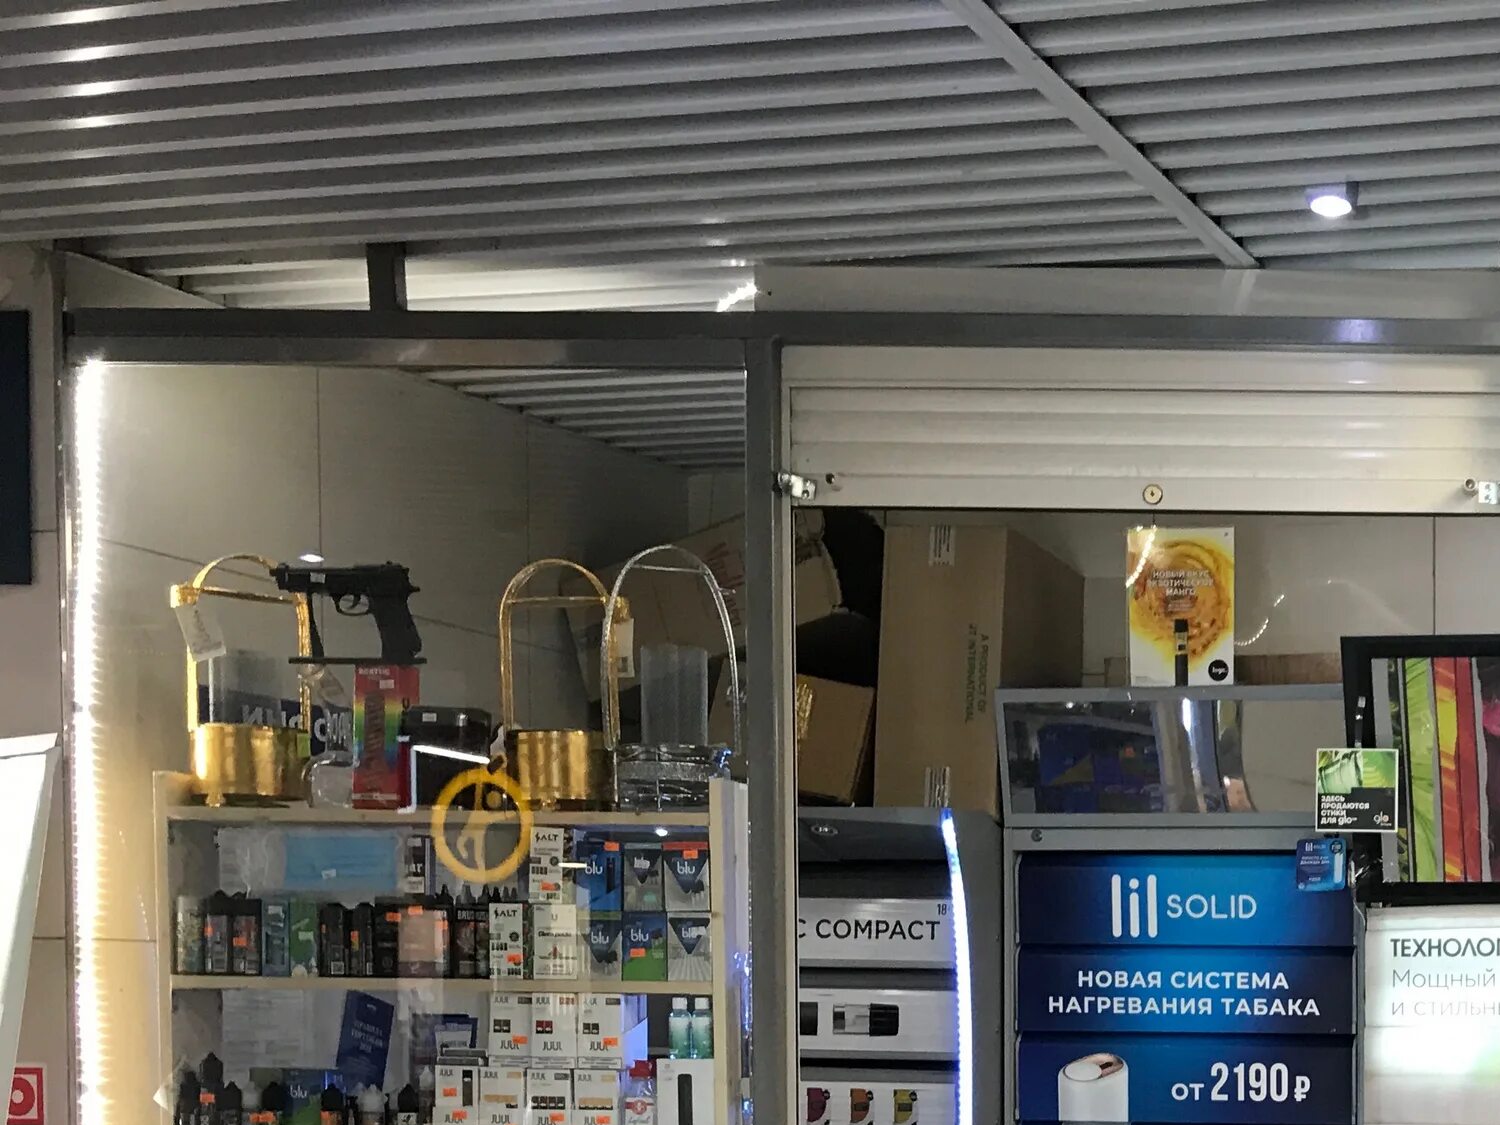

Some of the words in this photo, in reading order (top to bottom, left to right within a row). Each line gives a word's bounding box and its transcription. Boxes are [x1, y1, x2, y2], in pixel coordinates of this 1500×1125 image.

[677, 861, 695, 875] blu
[1166, 894, 1258, 919] SOLID
[591, 930, 610, 944] blu
[630, 928, 649, 943] blu
[815, 918, 941, 941] COMPACT
[1078, 970, 1162, 989] НОВАЯ
[1170, 971, 1289, 990] СИСТЕМА
[1392, 968, 1496, 990] Мощный
[1048, 996, 1213, 1015] НАГРЕВАНИЯ
[1221, 998, 1321, 1016] ТАБАКА
